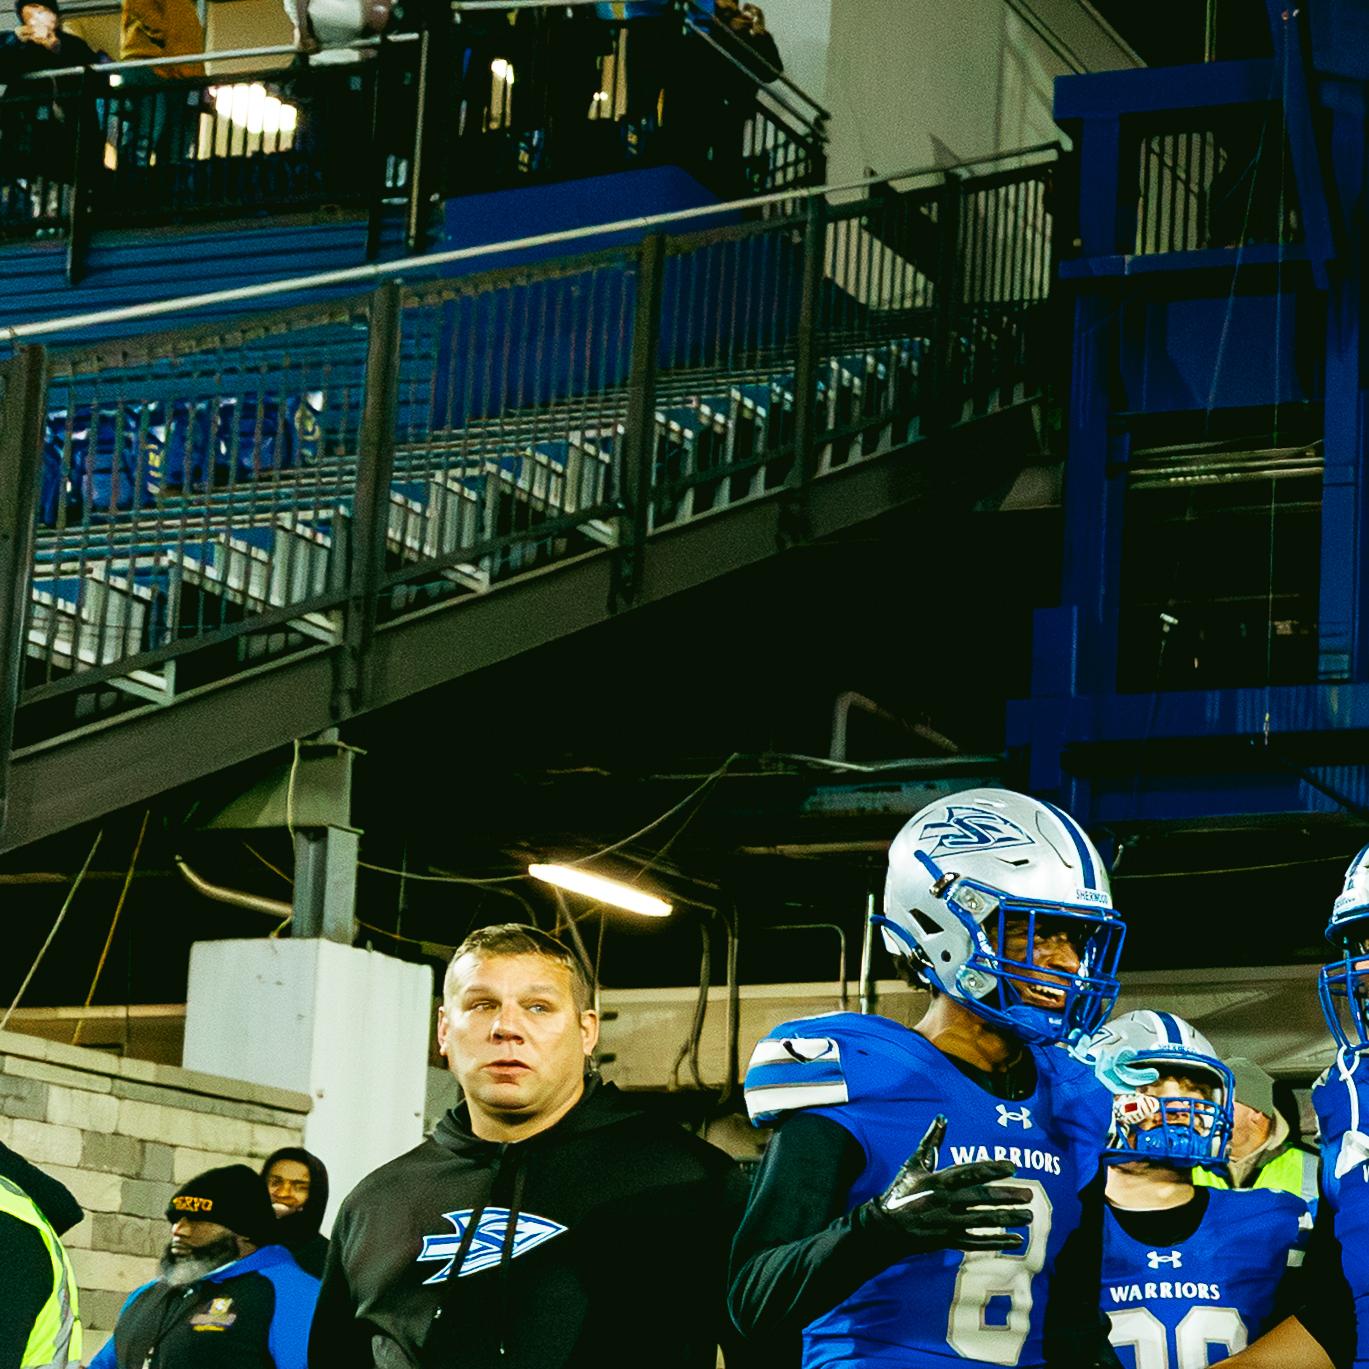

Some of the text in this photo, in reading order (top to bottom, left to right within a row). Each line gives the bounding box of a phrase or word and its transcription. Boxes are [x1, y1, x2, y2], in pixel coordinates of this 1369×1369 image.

[950, 1145, 1061, 1176] WARRIORS
[945, 1176, 1053, 1367] 8
[1109, 1282, 1221, 1303] WARRIORS
